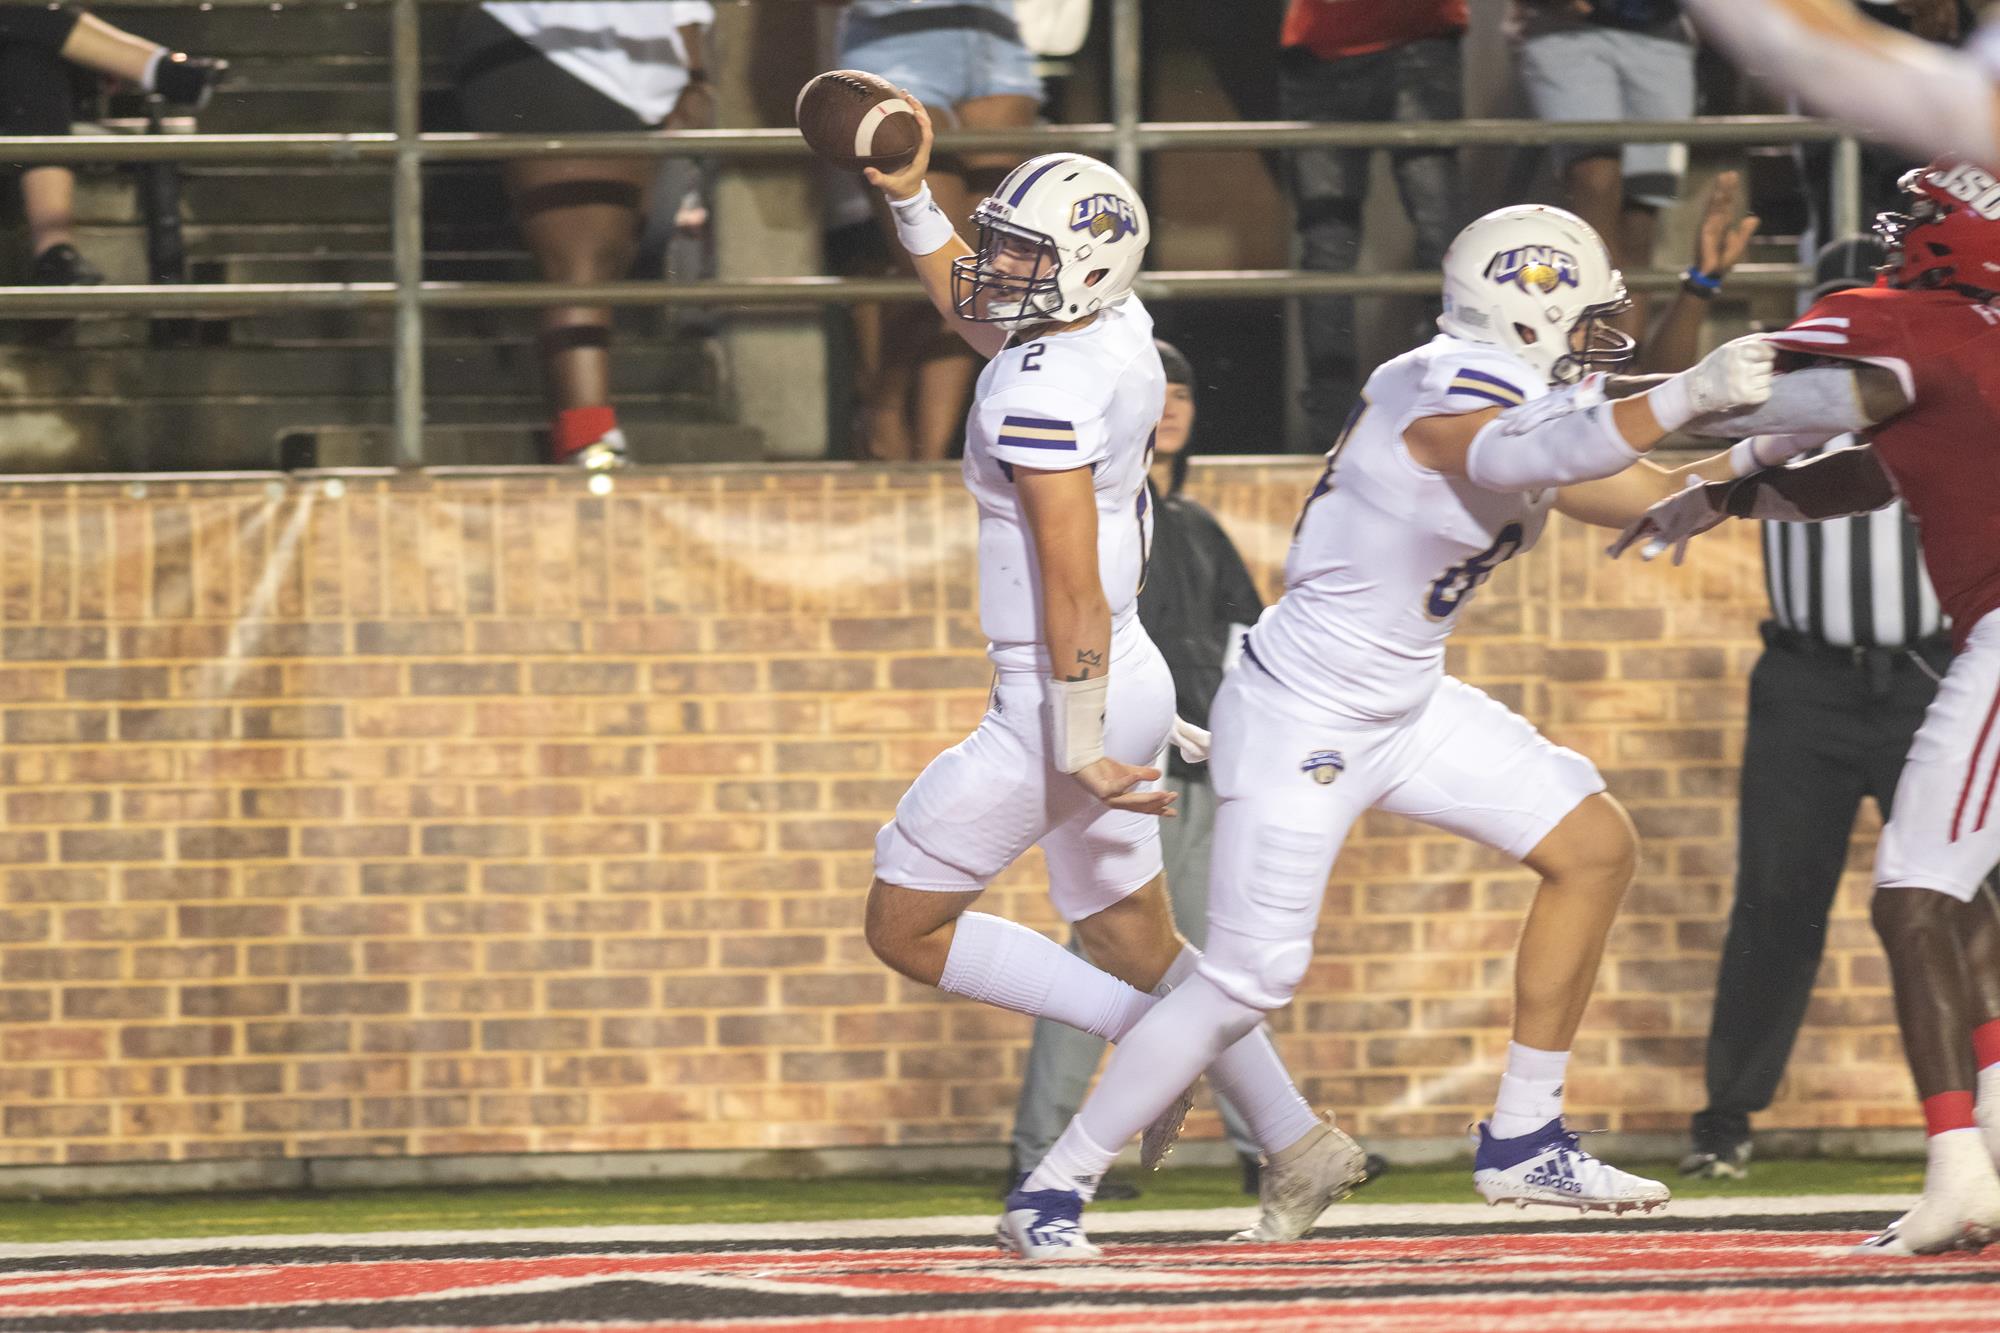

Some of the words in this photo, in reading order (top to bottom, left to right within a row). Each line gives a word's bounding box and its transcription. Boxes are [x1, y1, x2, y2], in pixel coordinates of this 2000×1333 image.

[1070, 193, 1139, 237] UNA
[1486, 245, 1579, 287] UNA
[1021, 342, 1046, 372] 2
[1524, 1173, 1583, 1193] adidas
